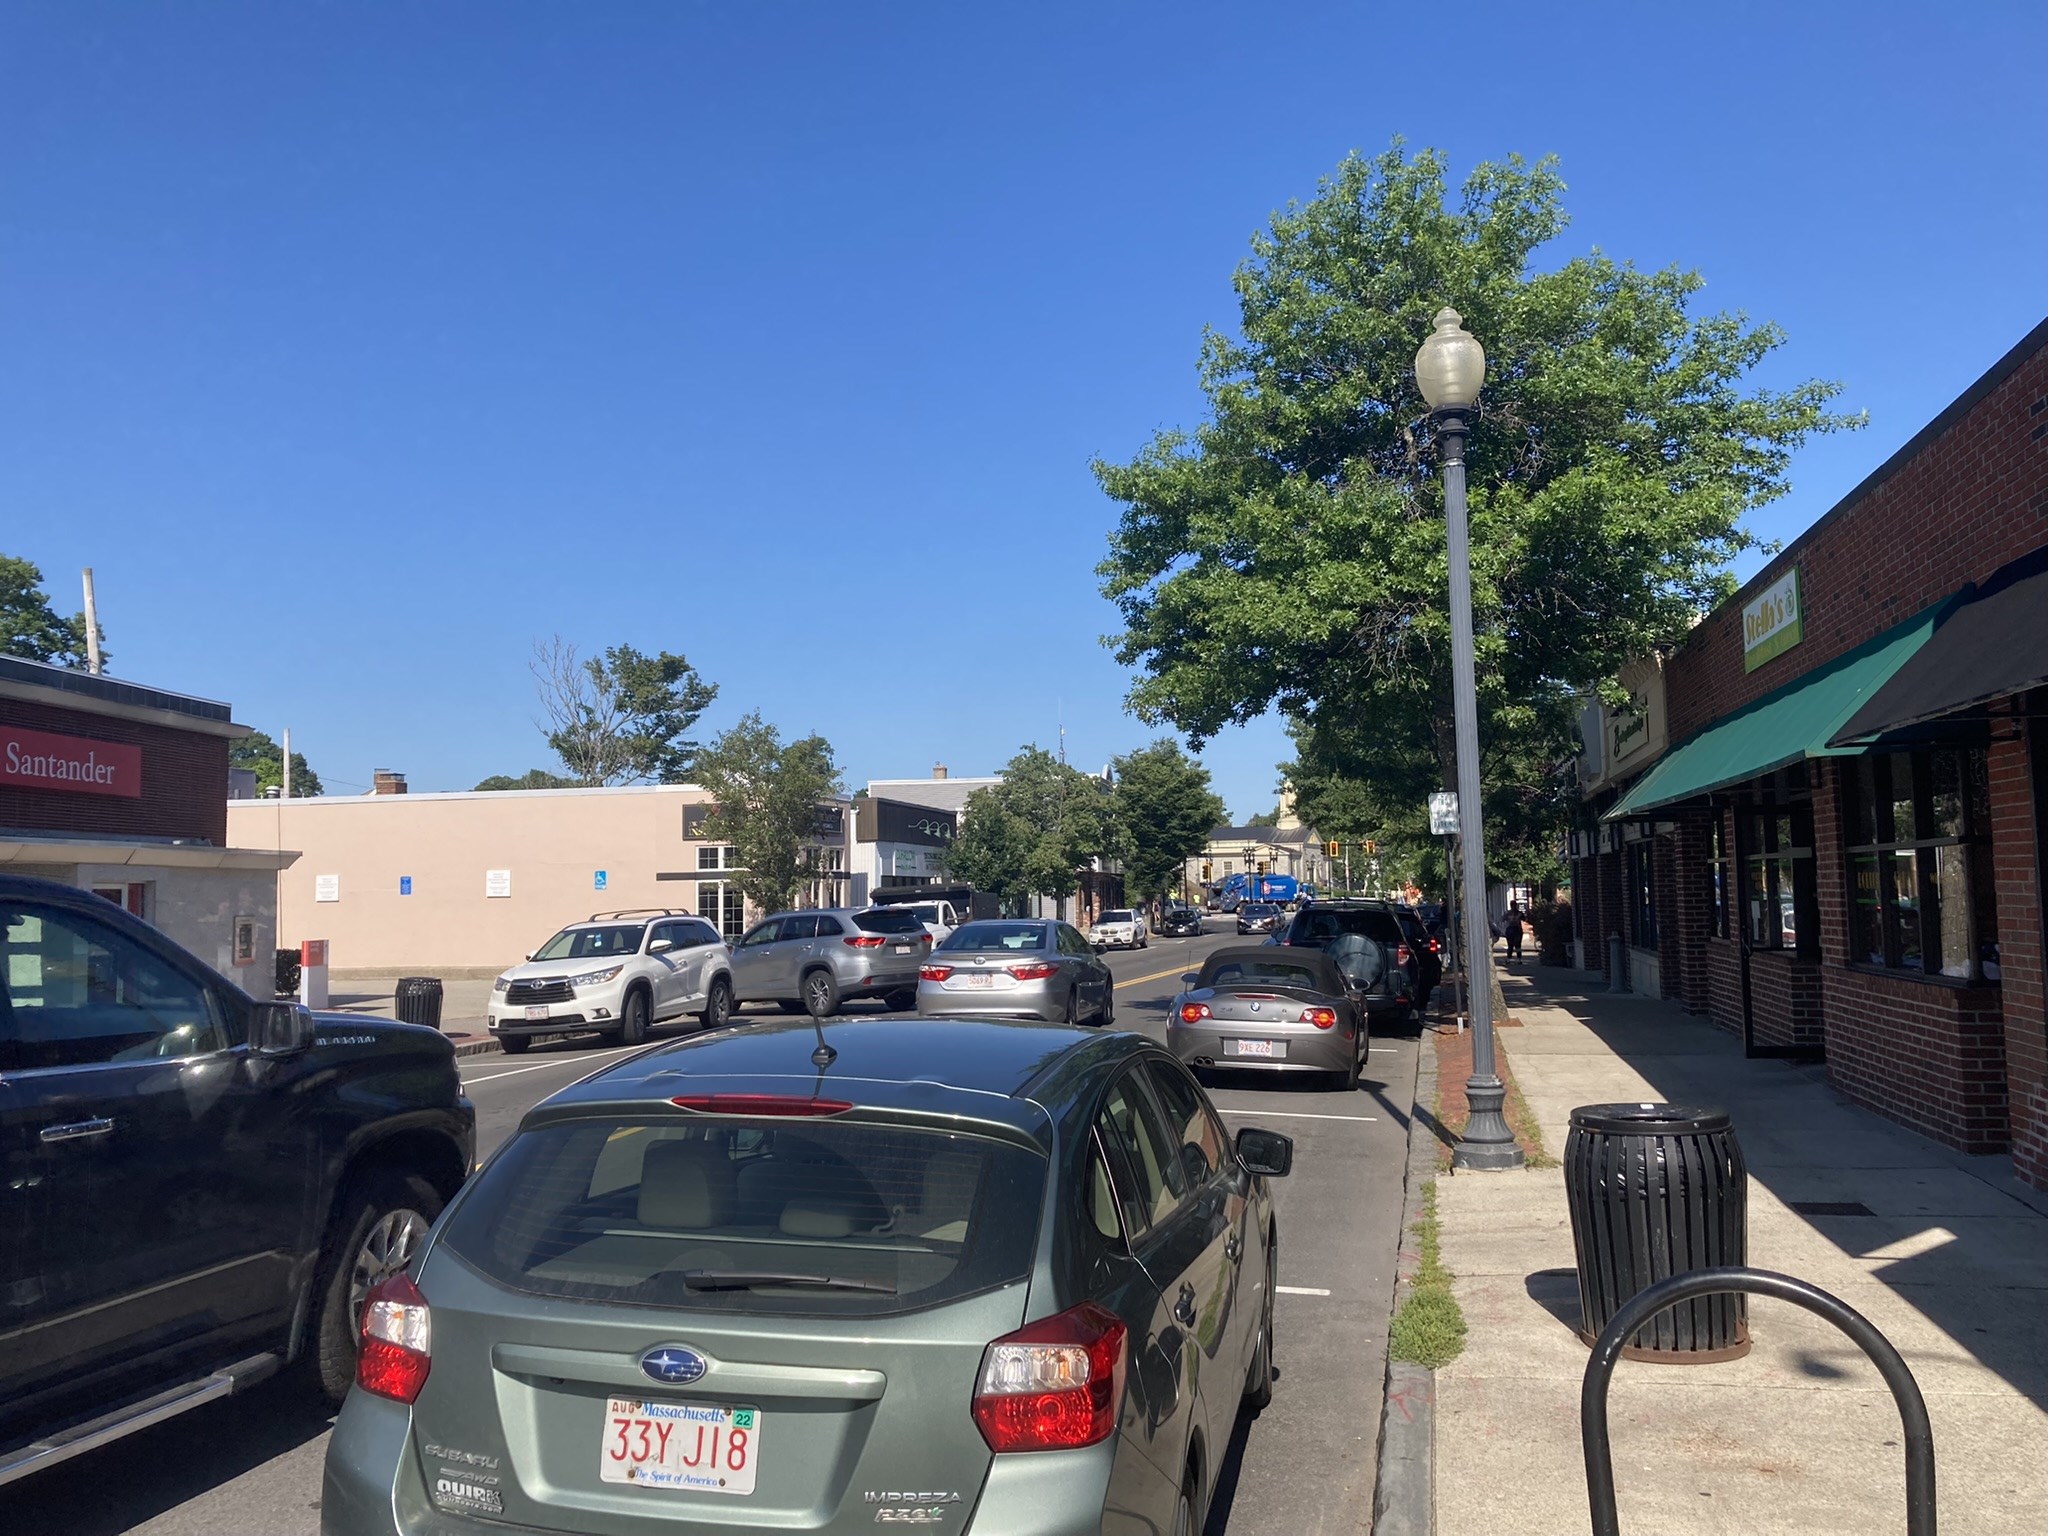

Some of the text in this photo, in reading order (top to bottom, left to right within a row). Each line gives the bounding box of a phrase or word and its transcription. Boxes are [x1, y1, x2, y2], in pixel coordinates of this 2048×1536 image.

[1746, 593, 1784, 645] Stella's
[5, 742, 115, 785] Santander
[612, 1401, 751, 1426] AUG Massachusetts 22
[610, 1418, 673, 1464] 33Y
[424, 1444, 500, 1470] SUBARU
[634, 1466, 718, 1487] The Spirit of America
[437, 1479, 501, 1505] QUIRK
[864, 1491, 963, 1504] IMPREZA
